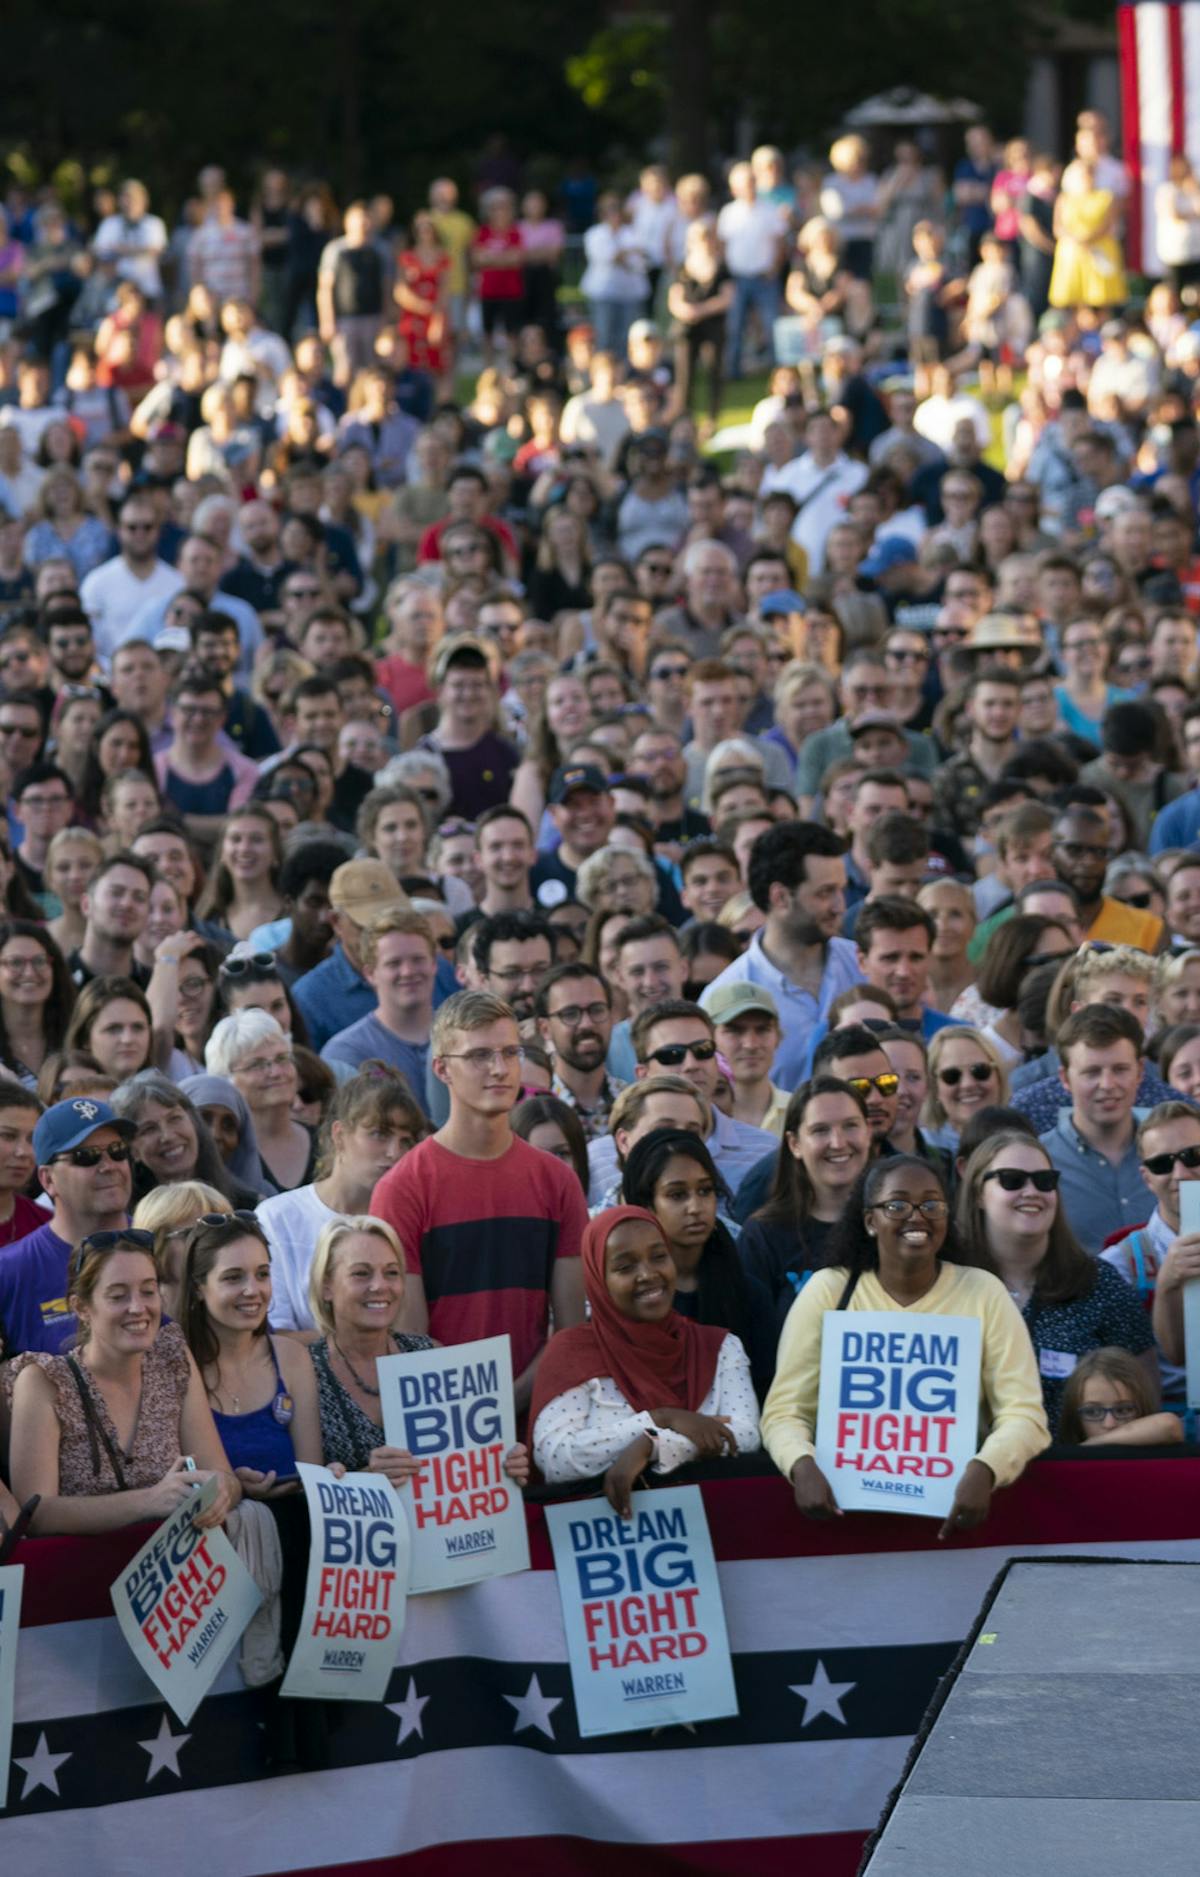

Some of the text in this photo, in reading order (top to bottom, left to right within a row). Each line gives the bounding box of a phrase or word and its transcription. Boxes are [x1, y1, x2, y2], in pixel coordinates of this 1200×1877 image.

[842, 1332, 959, 1367] DREAM
[399, 1360, 498, 1409] DREAM
[839, 1367, 956, 1412] BIG
[404, 1397, 502, 1455] BIG
[836, 1413, 956, 1453] FIGHT
[412, 1443, 505, 1499] FIGHT
[834, 1452, 954, 1478] HARD
[861, 1478, 925, 1497] WARREN
[317, 1482, 393, 1520] DREAM
[415, 1487, 509, 1529] HARD
[126, 1499, 202, 1598] DREAM
[323, 1518, 397, 1568] BIG
[445, 1528, 495, 1554] WARREN
[570, 1507, 688, 1552] DREAM
[130, 1524, 203, 1625] BIG
[142, 1535, 214, 1652] FIGHT
[318, 1568, 396, 1611] FIGHT
[575, 1542, 697, 1600] BIG
[158, 1564, 227, 1670] HARD
[188, 1607, 227, 1663] WARREN
[312, 1611, 392, 1641] HARD
[582, 1588, 701, 1643] FIGHT
[323, 1650, 365, 1669] WARREN
[589, 1631, 708, 1672] HARD
[621, 1672, 686, 1697] WARREN
